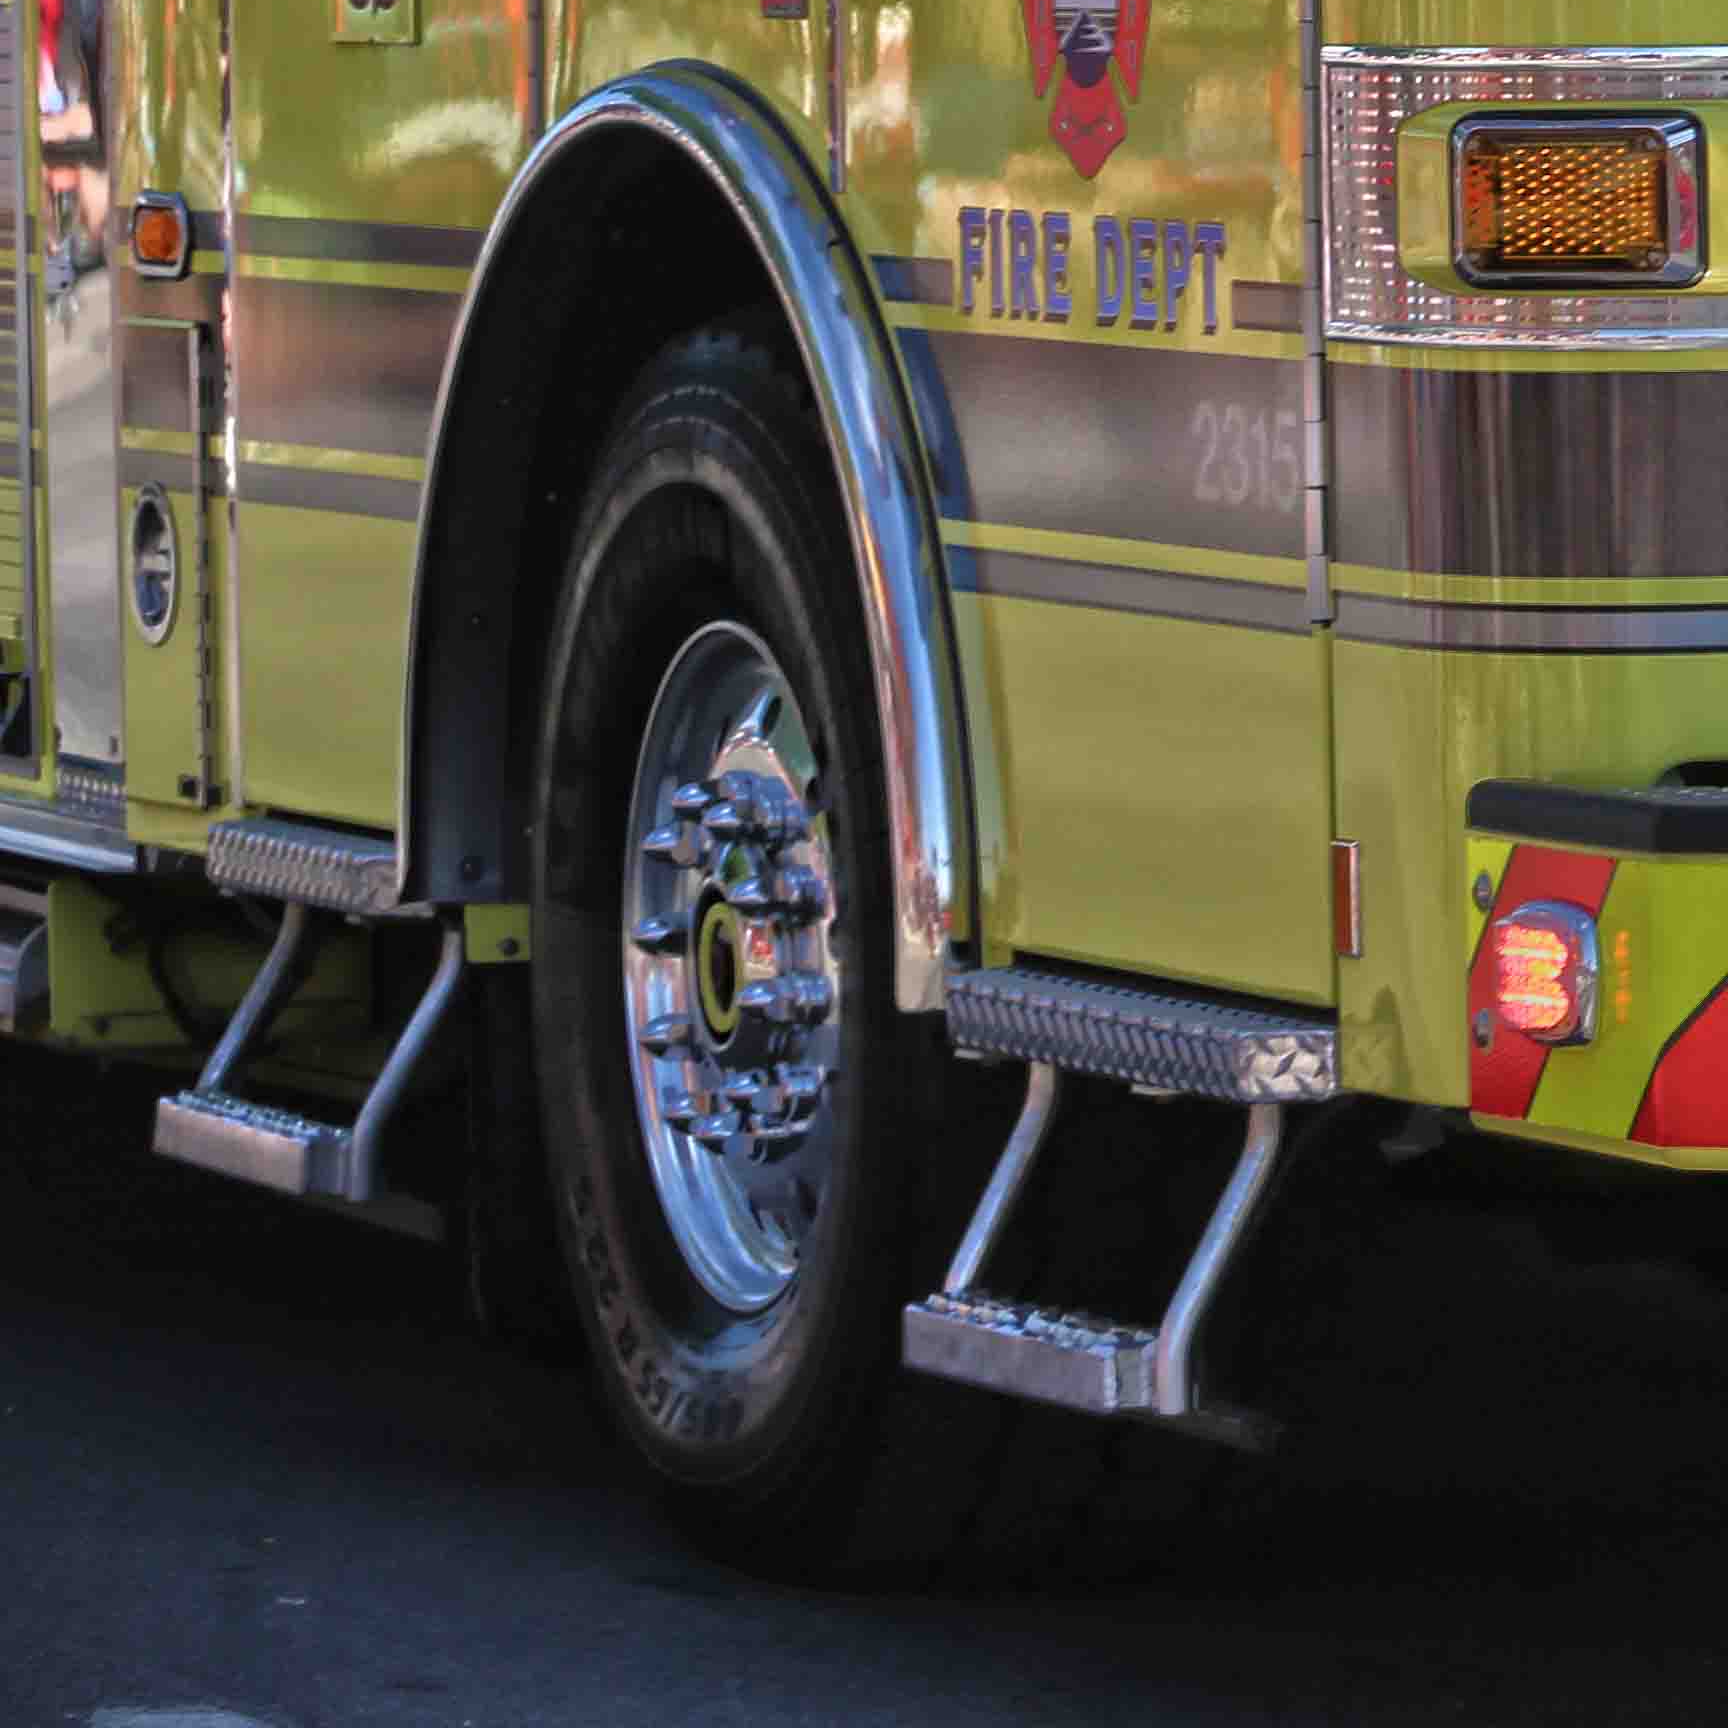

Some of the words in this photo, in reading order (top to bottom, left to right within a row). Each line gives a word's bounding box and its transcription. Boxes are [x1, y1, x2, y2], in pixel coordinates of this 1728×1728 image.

[958, 205, 1073, 323] FIRE
[1093, 214, 1226, 336] DEPT
[1193, 401, 1300, 513] 2315
